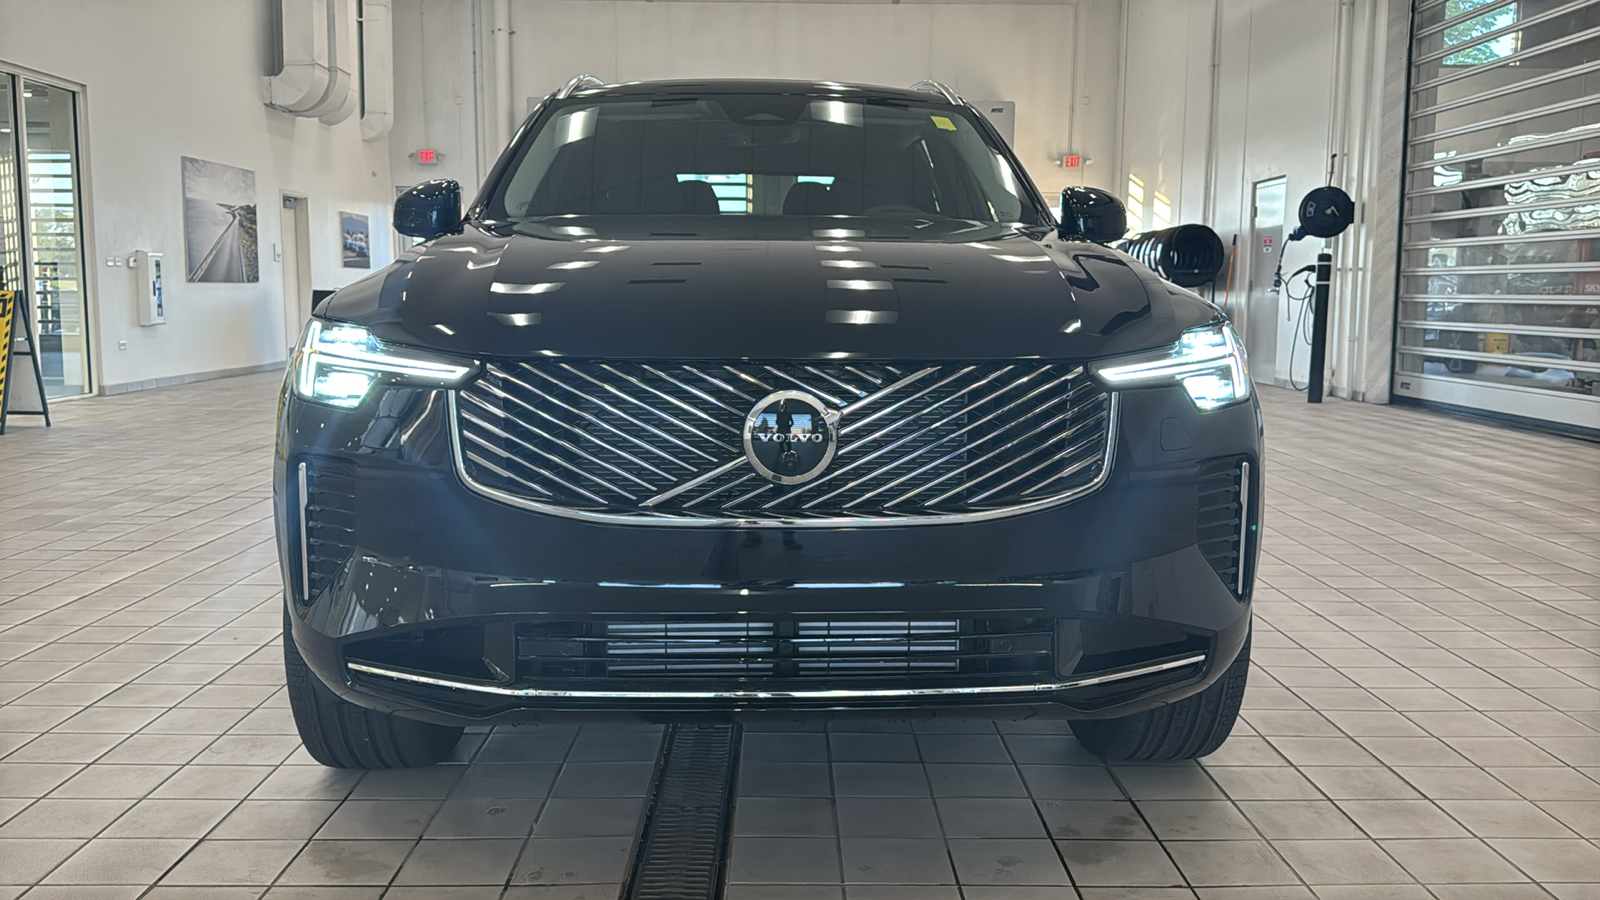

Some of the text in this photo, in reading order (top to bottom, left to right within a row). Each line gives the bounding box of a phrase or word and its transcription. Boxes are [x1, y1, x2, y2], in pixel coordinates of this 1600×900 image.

[419, 150, 434, 162] EXIT
[1065, 156, 1080, 168] EXIT
[757, 433, 823, 442] VOLVO
